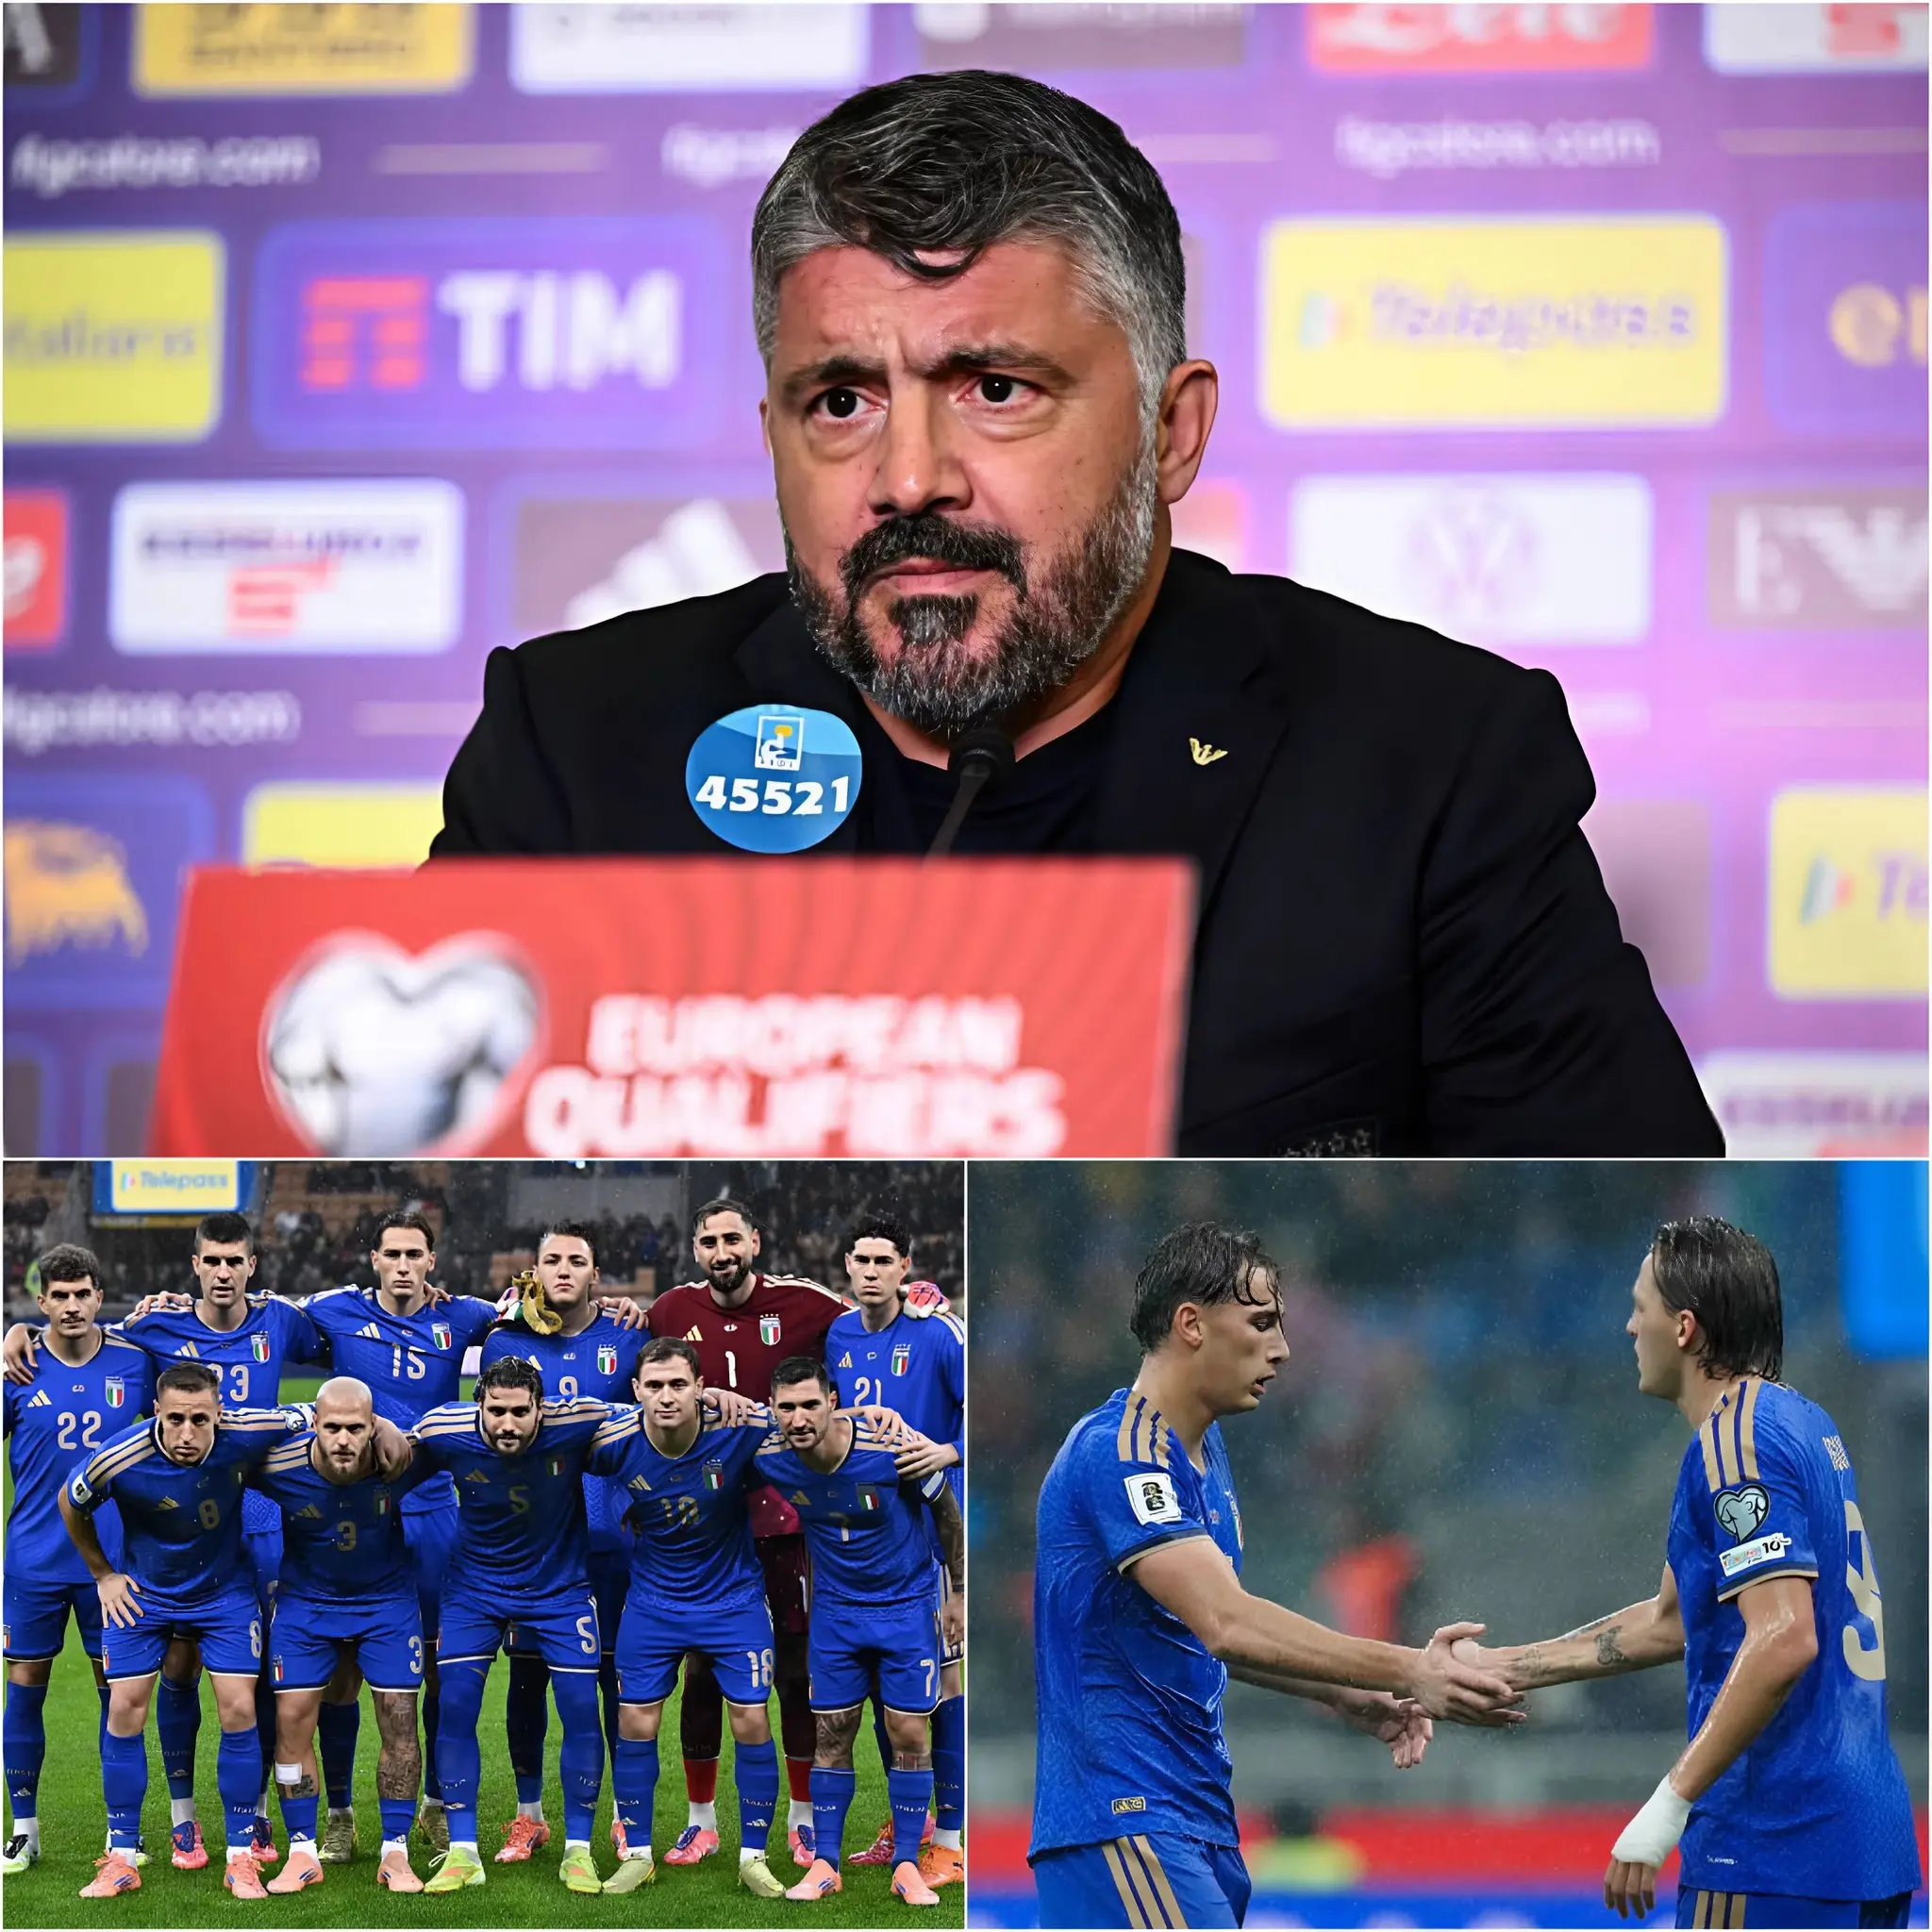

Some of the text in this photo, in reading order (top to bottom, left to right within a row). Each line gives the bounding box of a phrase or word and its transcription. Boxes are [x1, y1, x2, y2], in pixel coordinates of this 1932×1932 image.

[440, 272, 680, 389] TIM
[695, 775, 849, 816] 45521
[590, 996, 1022, 1071] EUROPEAN
[525, 1069, 1066, 1158] QUALIFIERS
[140, 1172, 228, 1190] Telepass
[392, 1343, 425, 1379] 15
[724, 1351, 737, 1388] 1
[854, 1377, 881, 1407] 21
[58, 1411, 102, 1450] 22
[198, 1499, 221, 1530] 8
[509, 1486, 529, 1514] 5
[337, 1521, 357, 1551] 3
[249, 1620, 262, 1658] 8
[576, 1616, 596, 1654] 5
[408, 1636, 424, 1674] 3
[747, 1648, 774, 1688] 18
[921, 1658, 936, 1697] 7
